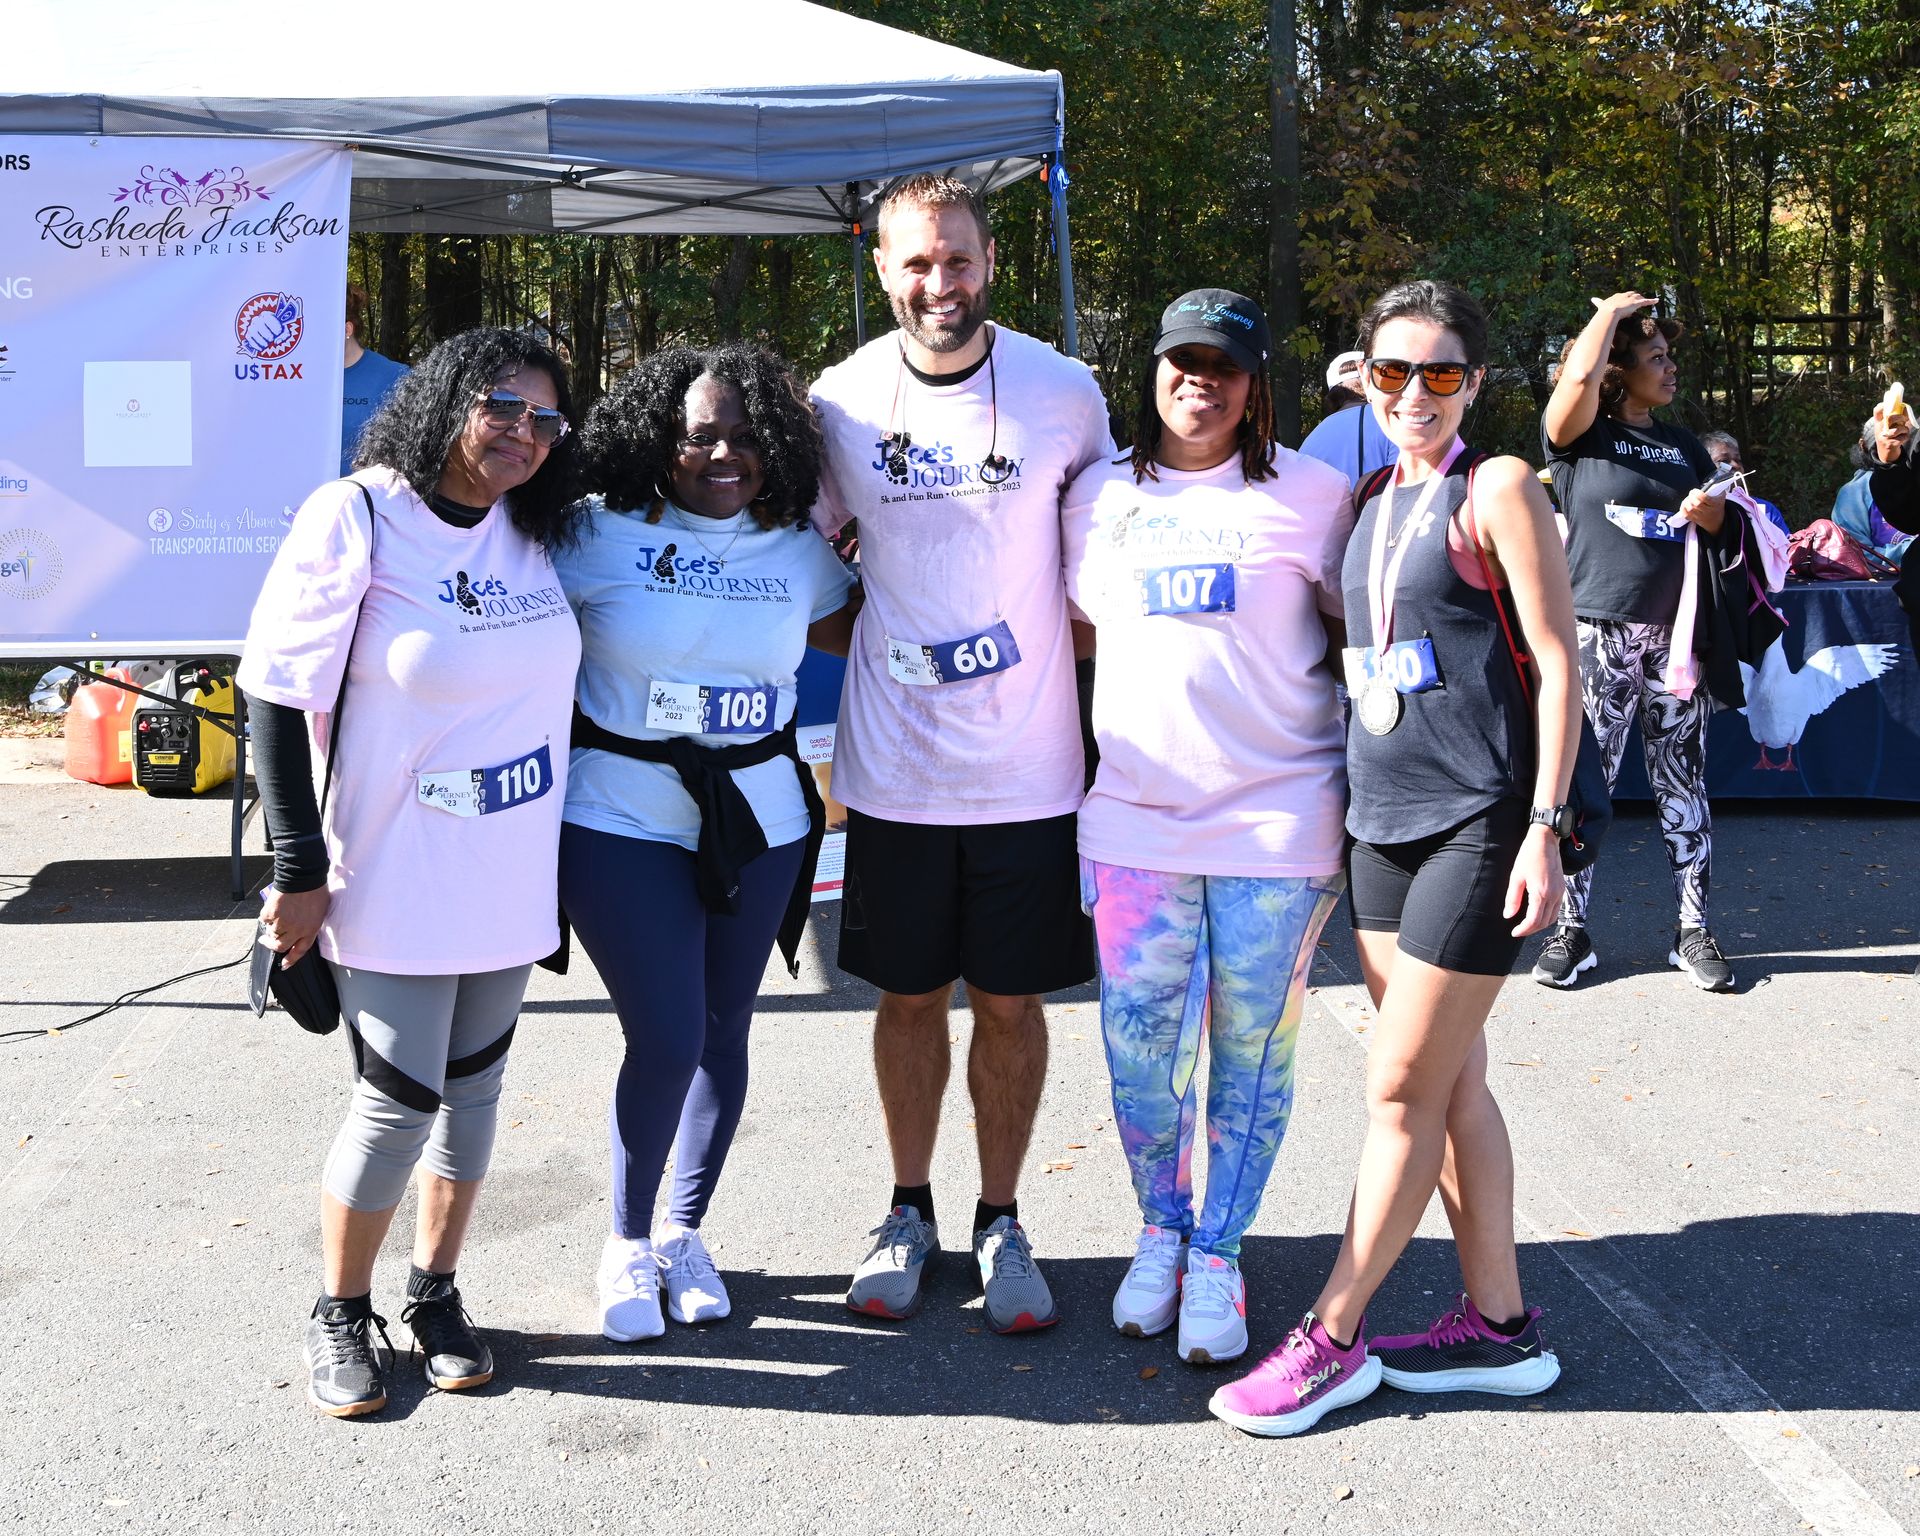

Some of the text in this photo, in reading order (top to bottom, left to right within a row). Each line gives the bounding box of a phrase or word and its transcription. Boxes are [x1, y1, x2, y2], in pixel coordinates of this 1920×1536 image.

[0, 155, 31, 170] RS
[35, 202, 344, 249] Rasheda Jackson
[101, 241, 283, 258] ENTERPRISES
[911, 458, 1025, 488] JOURNY
[881, 495, 890, 504] 5k
[892, 494, 906, 503] and
[908, 492, 924, 501] Fun
[927, 491, 944, 500] Run
[951, 487, 985, 498] October
[1002, 482, 1021, 492] 2023
[150, 537, 253, 555] TRANSPORTATION
[644, 584, 655, 592] 5k
[658, 585, 674, 594] and
[677, 587, 694, 596] Fun
[696, 590, 714, 599] Run
[722, 594, 759, 602] October
[679, 574, 790, 593] JOURNEY
[1156, 568, 1217, 608] 107
[482, 586, 564, 618] JOURNEY
[459, 624, 471, 633] 5k
[472, 622, 486, 632] and
[486, 621, 500, 631] Fun
[501, 619, 517, 628] Run
[521, 611, 550, 624] October
[953, 636, 999, 674] 60
[905, 667, 918, 675] 2023
[700, 690, 710, 698] 5K
[662, 703, 698, 713] JOURNEY
[664, 711, 683, 720] 2023
[718, 691, 767, 727] 108
[473, 773, 483, 782] 5K
[497, 757, 541, 804] 110
